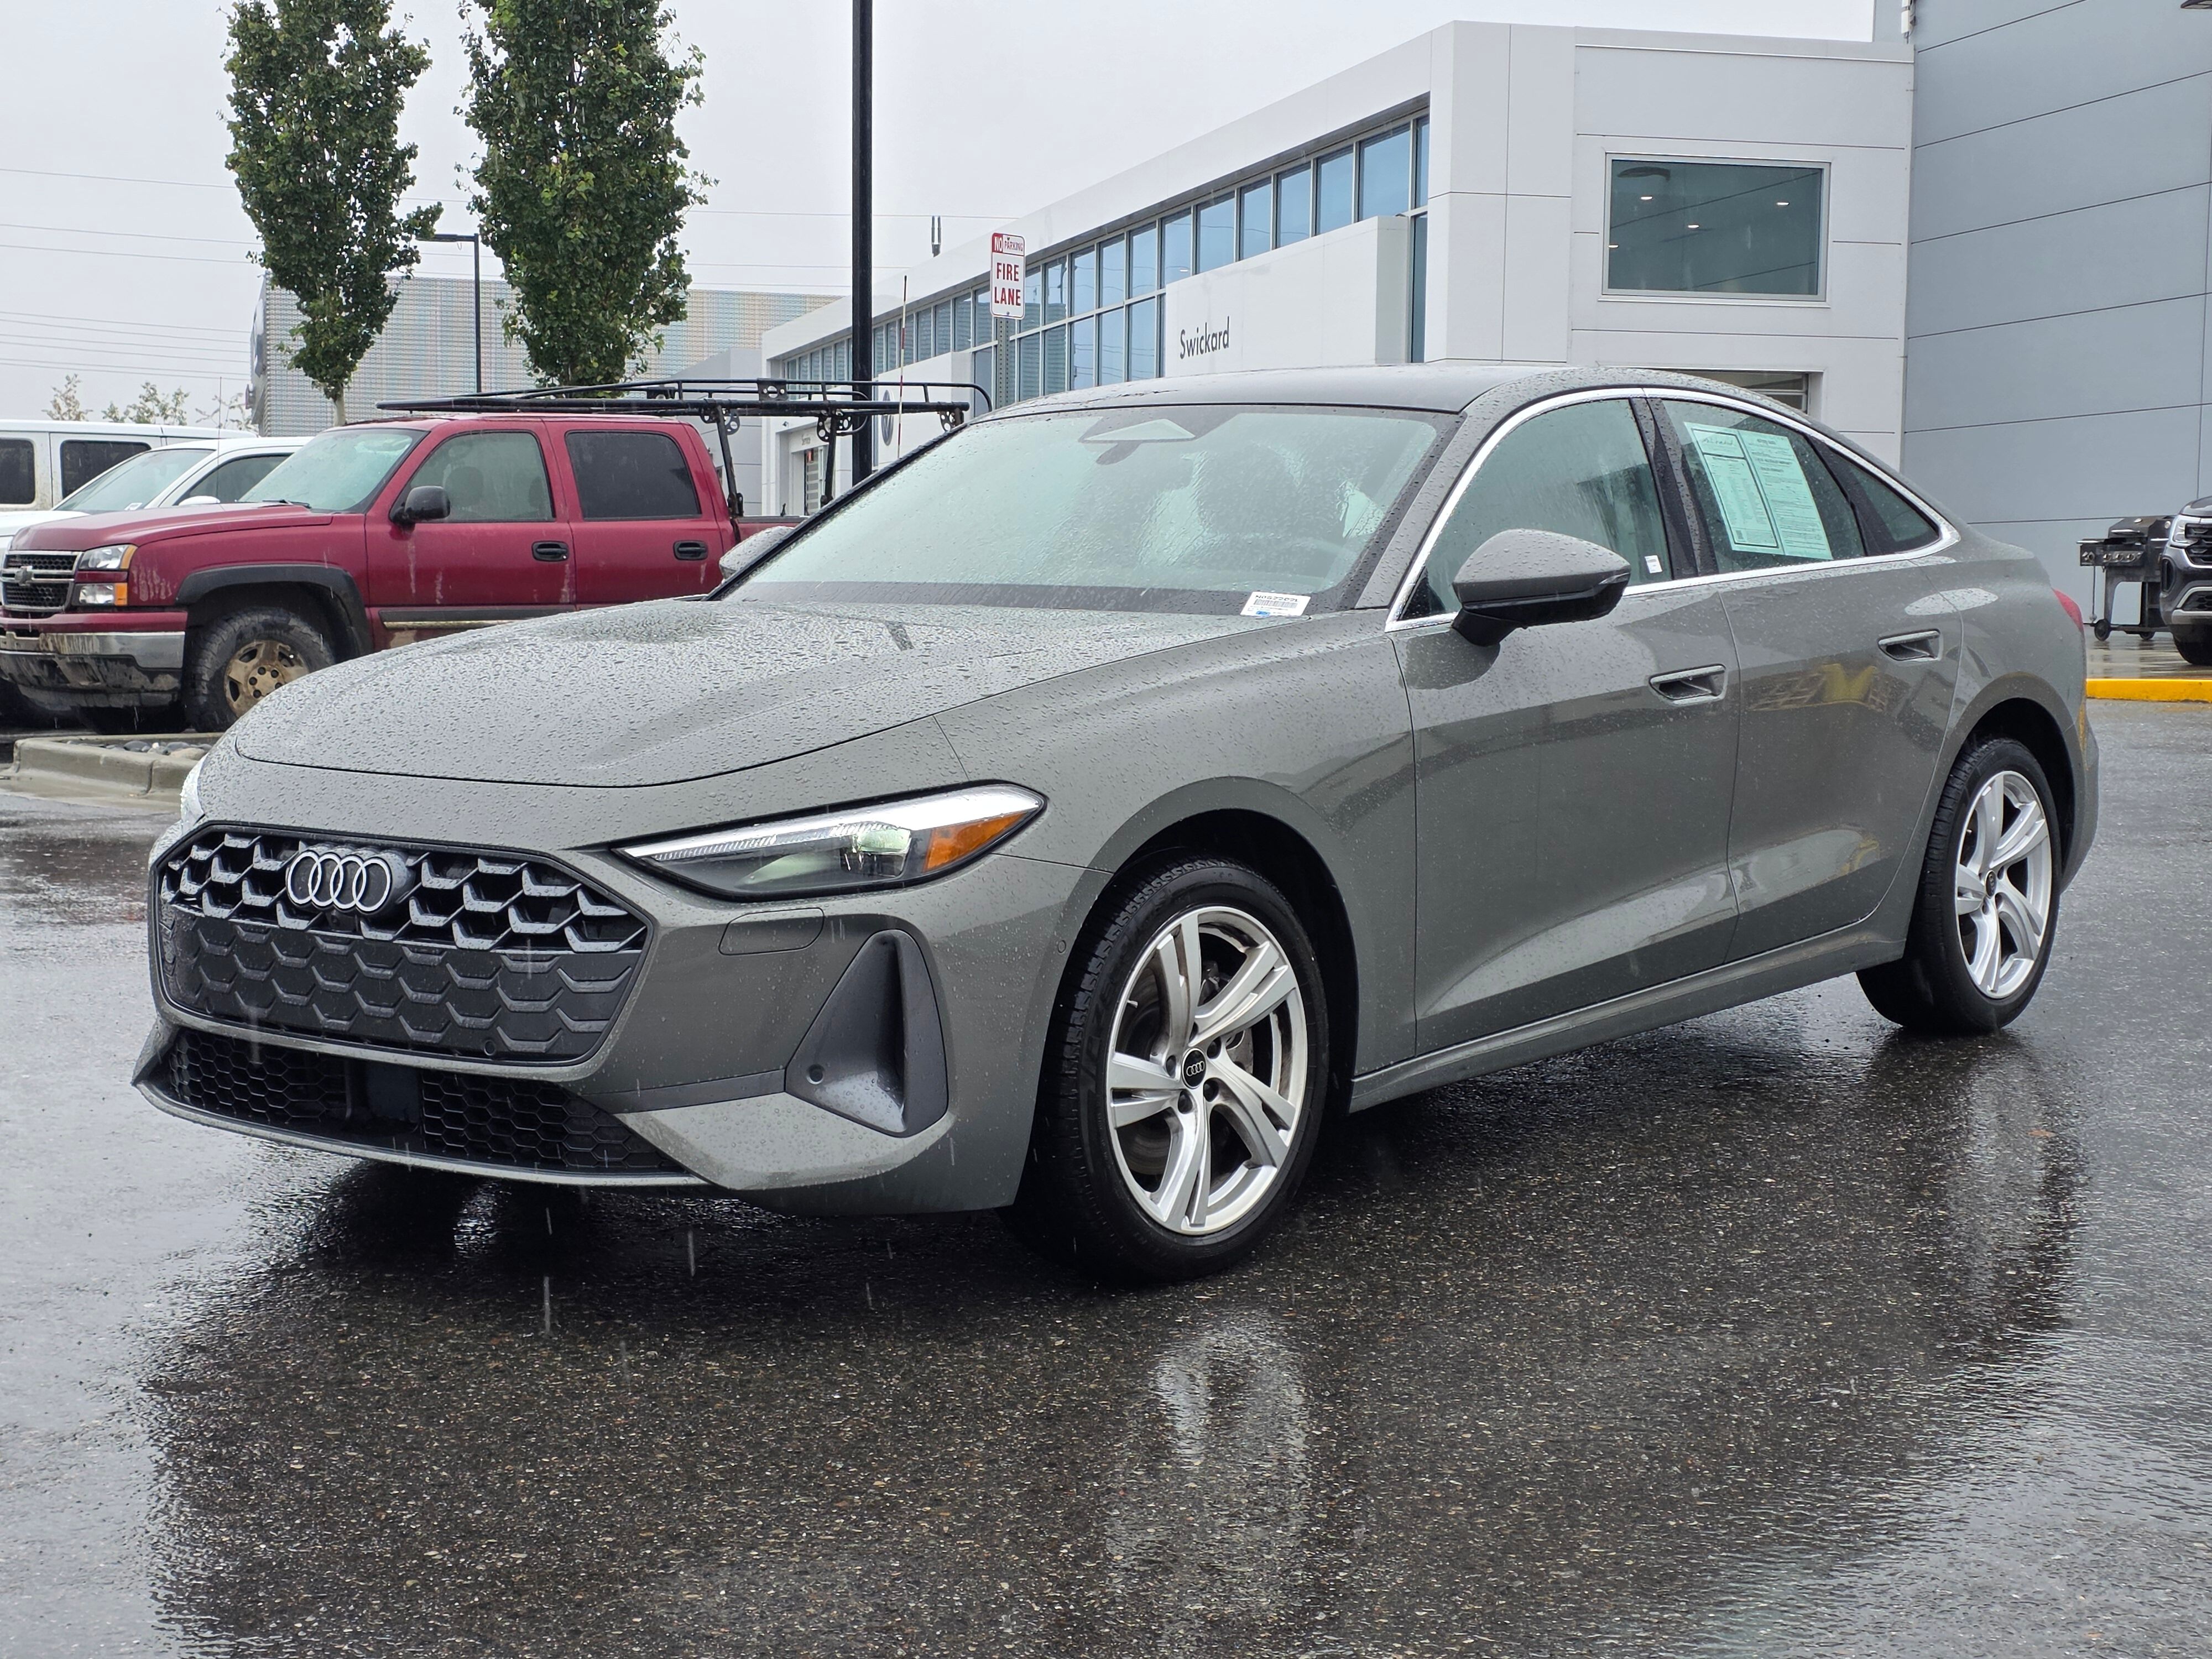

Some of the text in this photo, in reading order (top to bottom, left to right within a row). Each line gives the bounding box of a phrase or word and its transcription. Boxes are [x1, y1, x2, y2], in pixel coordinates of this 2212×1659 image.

[994, 236, 1023, 252] NO PARKING
[997, 262, 1019, 281] FIRE
[994, 286, 1021, 306] LANE
[1180, 316, 1229, 359] Swickard
